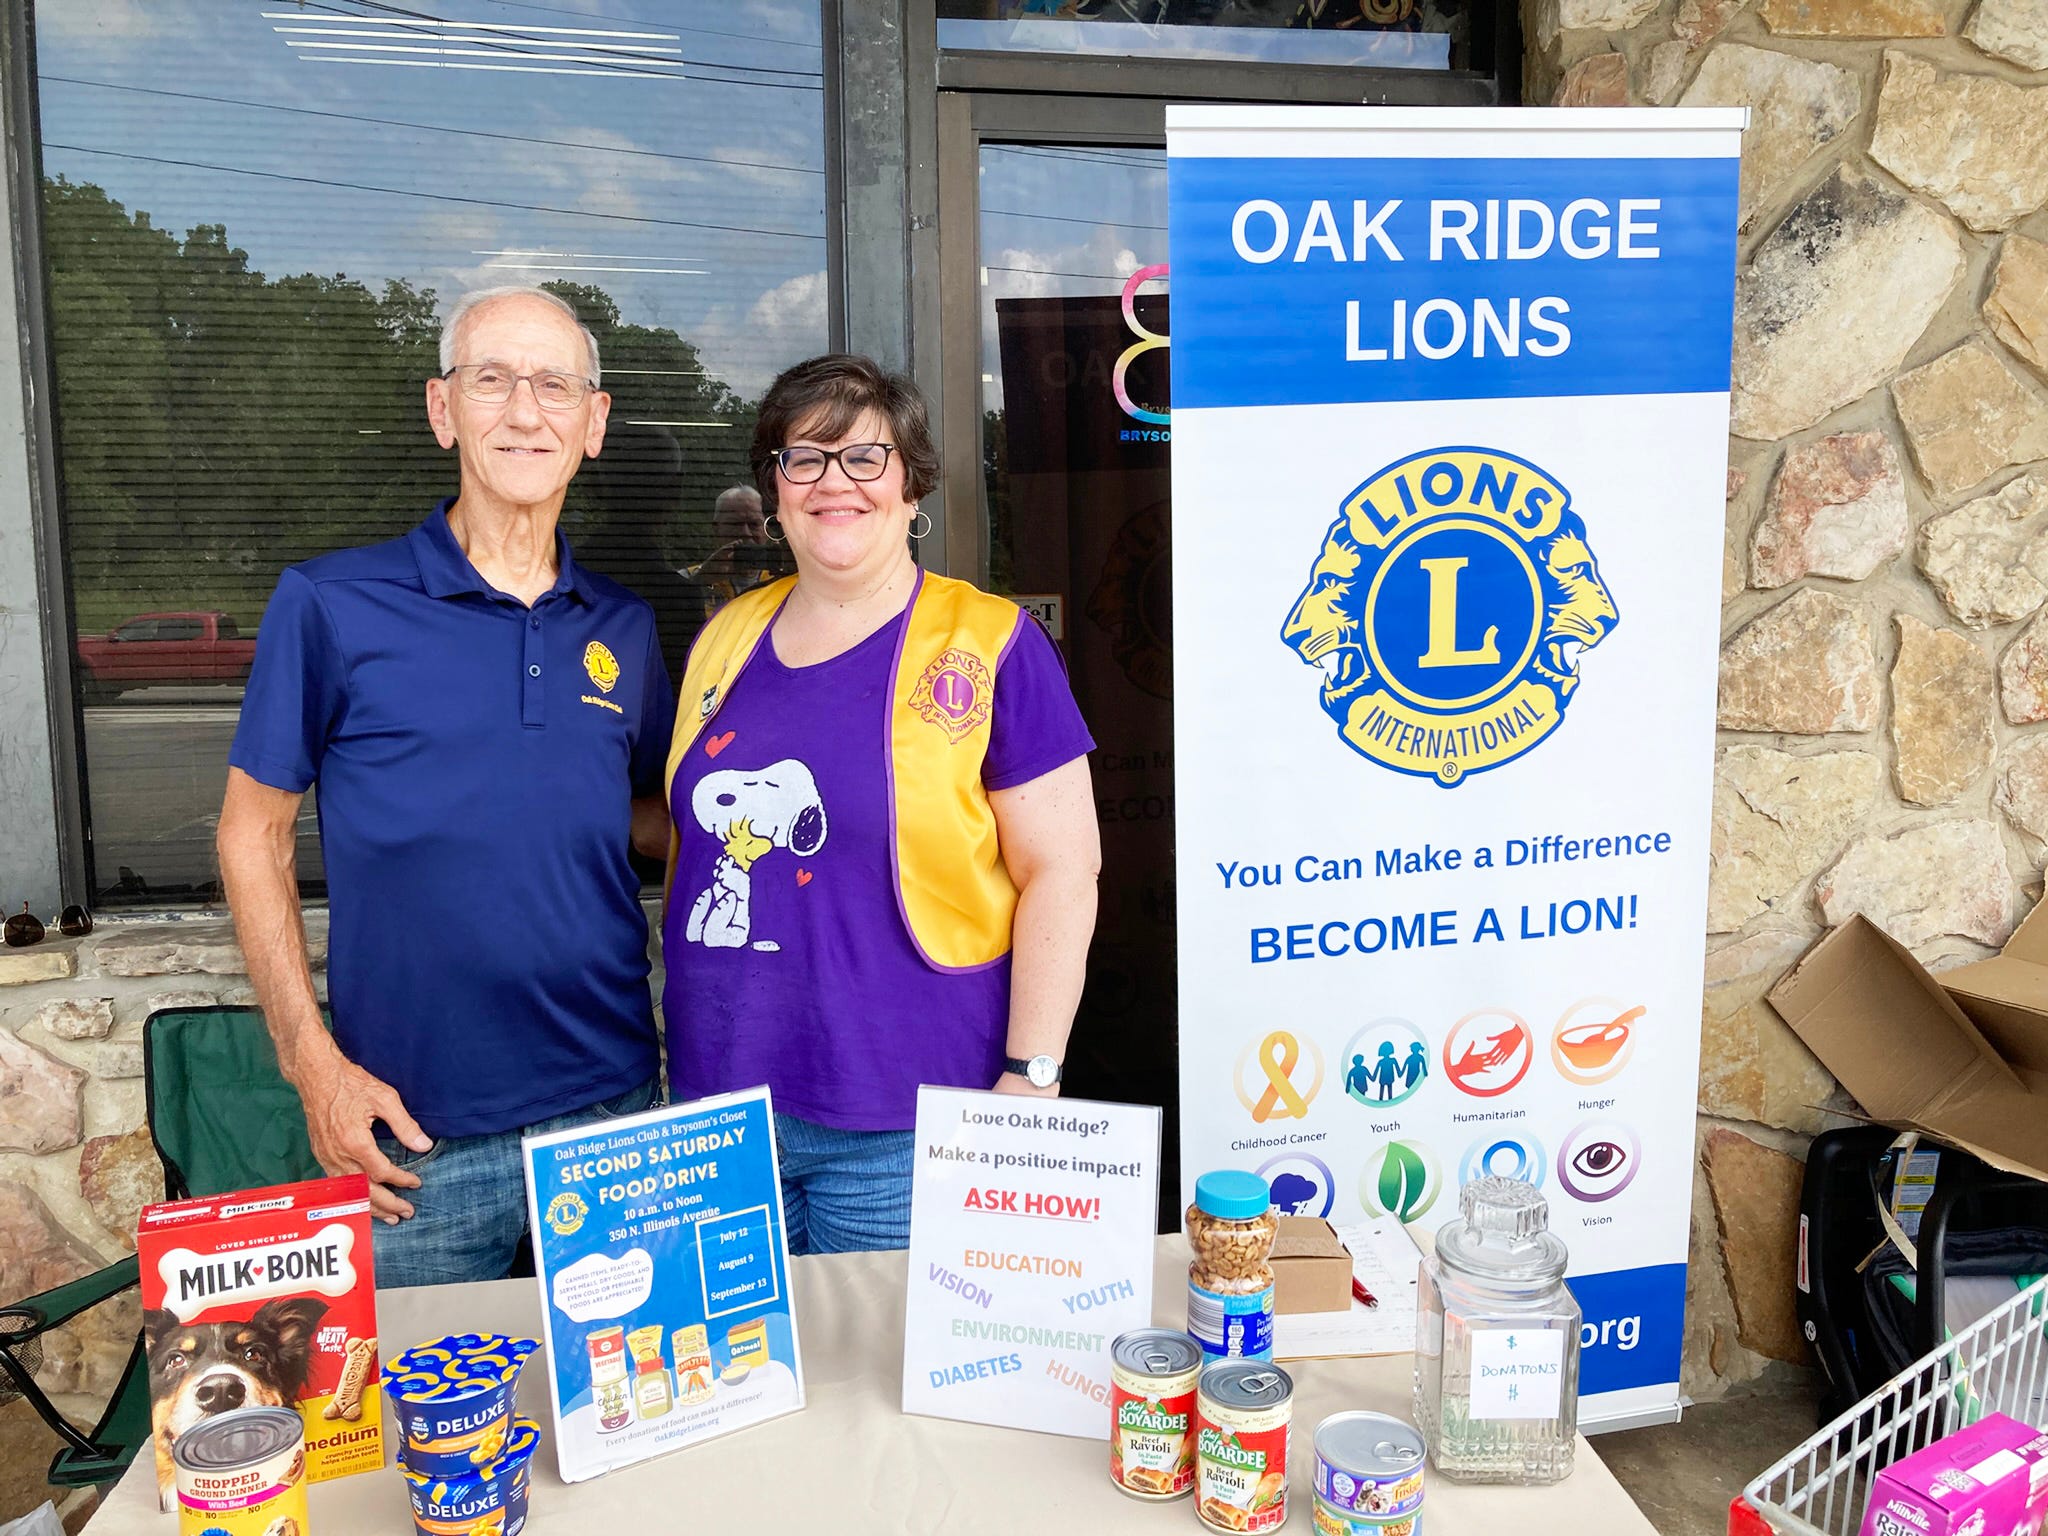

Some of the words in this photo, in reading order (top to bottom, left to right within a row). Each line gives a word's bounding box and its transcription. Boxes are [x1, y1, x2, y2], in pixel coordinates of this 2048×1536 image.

[1231, 199, 1404, 264] OAK
[1429, 198, 1662, 262] RIDGE
[1345, 296, 1572, 362] LIONS
[1360, 461, 1553, 538] LIONS
[1418, 557, 1501, 668] L
[598, 659, 609, 674] L
[933, 653, 975, 672] LIONS
[943, 675, 963, 710] L
[1360, 698, 1545, 759] INTERNATIONAL
[1216, 861, 1282, 889] You
[1294, 854, 1362, 884] Can
[1375, 845, 1462, 877] Make
[1474, 846, 1494, 868] a
[1505, 828, 1672, 867] Difference
[1250, 910, 1458, 964] BECOME
[1473, 908, 1505, 944] A
[1521, 894, 1639, 940] LION!
[1578, 1097, 1616, 1111] Hunger
[962, 1109, 1004, 1126] Love
[1008, 1113, 1043, 1130] Oak
[1048, 1116, 1109, 1137] Ridge?
[1453, 1108, 1527, 1123] Humanitarian
[555, 1148, 576, 1160] Oak
[578, 1142, 606, 1157] Ridge
[608, 1137, 635, 1150] Lions
[637, 1130, 659, 1143] Club
[661, 1127, 670, 1138] &
[672, 1114, 718, 1135] Brysonn's
[719, 1110, 747, 1124] Closet
[1370, 1120, 1401, 1133] Youth
[1231, 1135, 1286, 1151] Childhood
[1289, 1131, 1328, 1146] Cancer
[560, 1151, 642, 1185] SECOND
[649, 1126, 746, 1165] SATURDAY
[928, 1145, 976, 1163] Make
[980, 1151, 990, 1163] a
[994, 1151, 1068, 1171] positive
[1072, 1157, 1141, 1178] impact!
[599, 1177, 657, 1206] FOOD
[664, 1162, 718, 1190] DRIVE
[227, 1199, 288, 1215] MILK-BONE
[562, 1206, 574, 1222] L
[623, 1210, 636, 1221] 10
[638, 1203, 661, 1217] a.m.
[663, 1200, 674, 1211] to
[676, 1192, 703, 1208] Noon
[964, 1188, 1018, 1212] ASK
[1024, 1193, 1100, 1220] HOW!
[609, 1229, 627, 1243] 350
[629, 1225, 641, 1237] N.
[643, 1215, 680, 1234] Illinois
[682, 1206, 720, 1224] Avenue
[1582, 1214, 1613, 1227] Vision
[215, 1240, 245, 1251] LOVED
[248, 1236, 275, 1246] SINCE
[720, 1230, 737, 1245] July
[739, 1227, 748, 1237] 12
[179, 1258, 255, 1301] MILK
[267, 1245, 340, 1283] BONE
[718, 1256, 747, 1271] August
[748, 1254, 754, 1263] 9
[964, 1249, 1083, 1278] EDUCATION
[565, 1273, 590, 1284] CANNED
[928, 1262, 993, 1309] VISION
[583, 1289, 599, 1298] COLD
[711, 1282, 755, 1301] September
[757, 1278, 767, 1288] 13
[1062, 1278, 1135, 1315] YOUTH
[317, 1331, 348, 1344] MEATY
[951, 1318, 1104, 1352] ENVIRONMENT
[319, 1343, 343, 1353] Taste
[731, 1340, 761, 1356] Oatmeal
[929, 1353, 1023, 1389] DIABETES
[1481, 1363, 1558, 1378] DONATIONS
[597, 1393, 628, 1407] Chicken
[1123, 1400, 1143, 1413] Chef
[437, 1399, 505, 1434] DELUXE
[605, 1436, 626, 1448] Every
[628, 1424, 660, 1440] donation
[661, 1421, 669, 1430] of
[670, 1415, 686, 1429] food
[687, 1413, 699, 1422] can
[700, 1406, 719, 1418] make
[1118, 1408, 1188, 1431] BOYARDEE
[654, 1417, 720, 1443] OakRidgeLions.org
[1141, 1435, 1160, 1444] Beef
[1201, 1428, 1218, 1442] Chef
[325, 1449, 352, 1460] crunchy
[354, 1443, 379, 1453] texture
[1130, 1438, 1171, 1454] Ravioli
[321, 1456, 340, 1466] helps
[341, 1453, 360, 1462] clean
[361, 1449, 380, 1458] teeth
[194, 1472, 260, 1489] CHOPPED
[1206, 1467, 1245, 1490] Ravioli
[1216, 1466, 1234, 1477] Beef
[190, 1488, 226, 1498] GROUND
[229, 1481, 268, 1497] DINNER
[208, 1501, 227, 1509] With
[228, 1498, 248, 1508] Beef
[248, 1505, 260, 1514] NO
[428, 1493, 499, 1518] DELUXE
[1886, 1499, 1932, 1531] Millville
